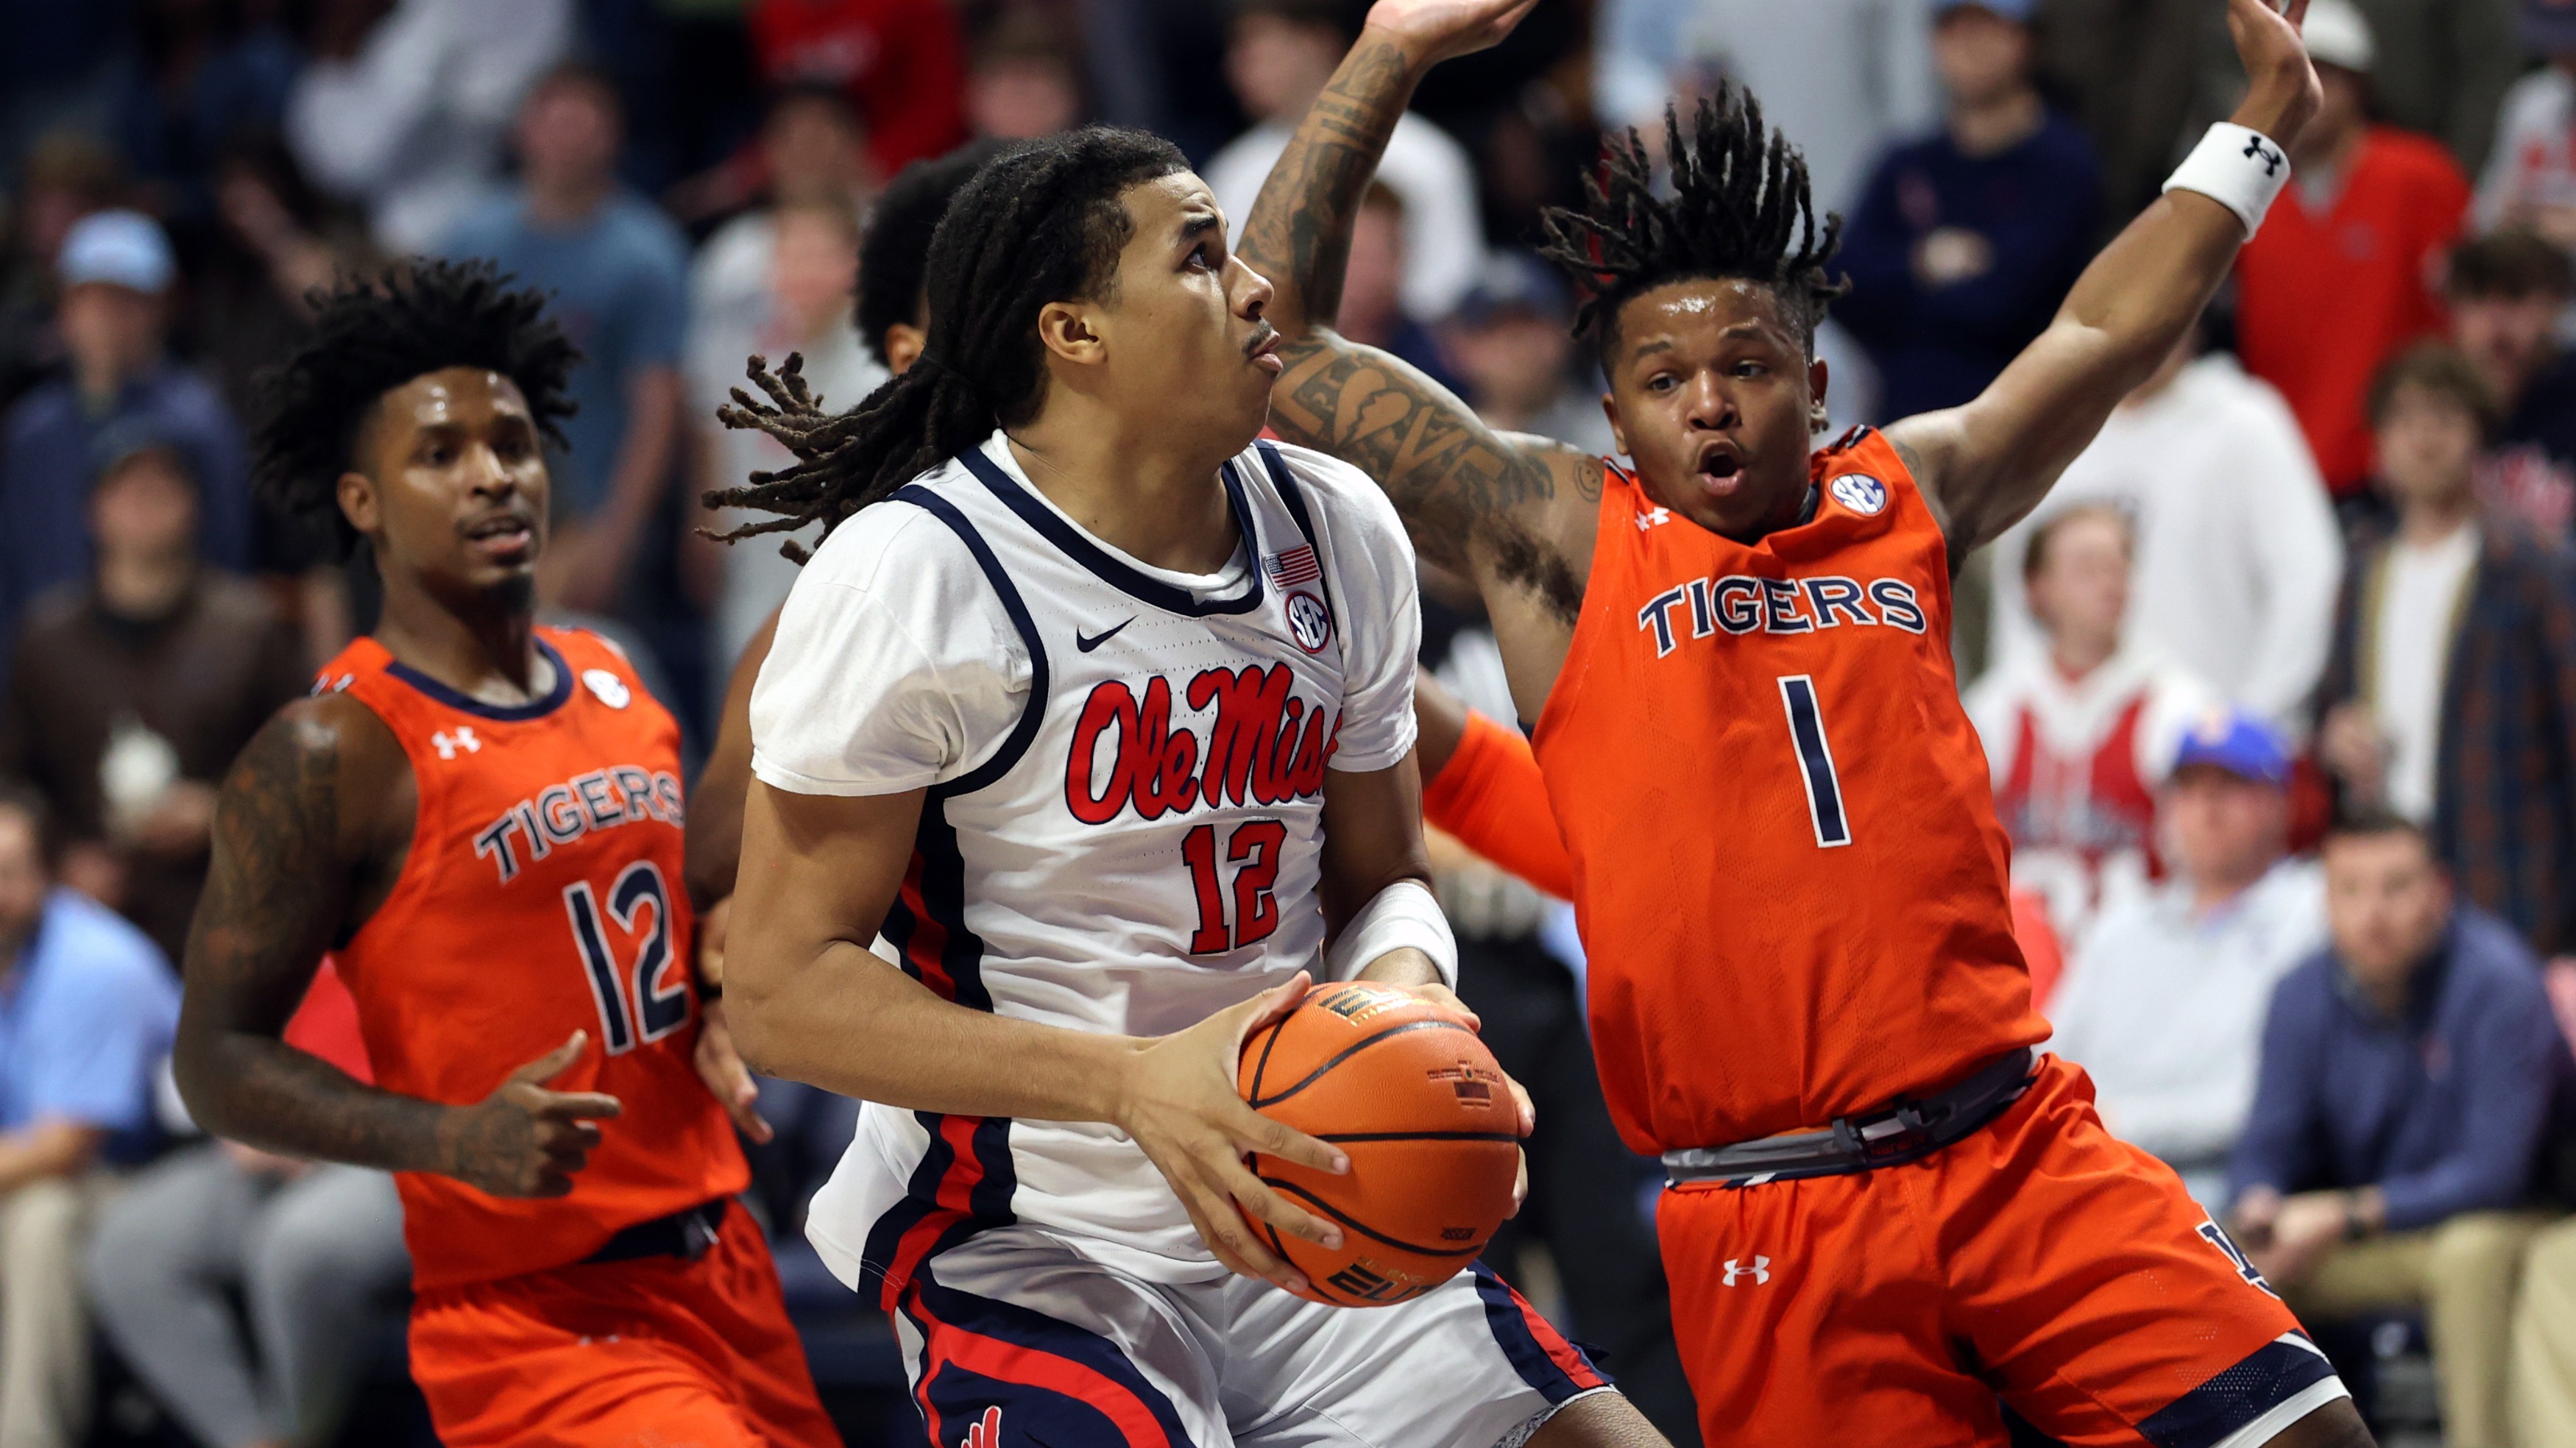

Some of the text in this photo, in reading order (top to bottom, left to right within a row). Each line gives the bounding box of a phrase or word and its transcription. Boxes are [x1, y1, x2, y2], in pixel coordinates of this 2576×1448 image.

[1831, 474, 1885, 514] SEC
[1289, 595, 1327, 649] SEC
[1638, 575, 1926, 659] TIGERS
[1065, 675, 1199, 825] Ole
[1777, 674, 1852, 848] 1
[473, 764, 684, 887] TIGERS
[1181, 820, 1287, 955] 12
[563, 859, 690, 1056] 12
